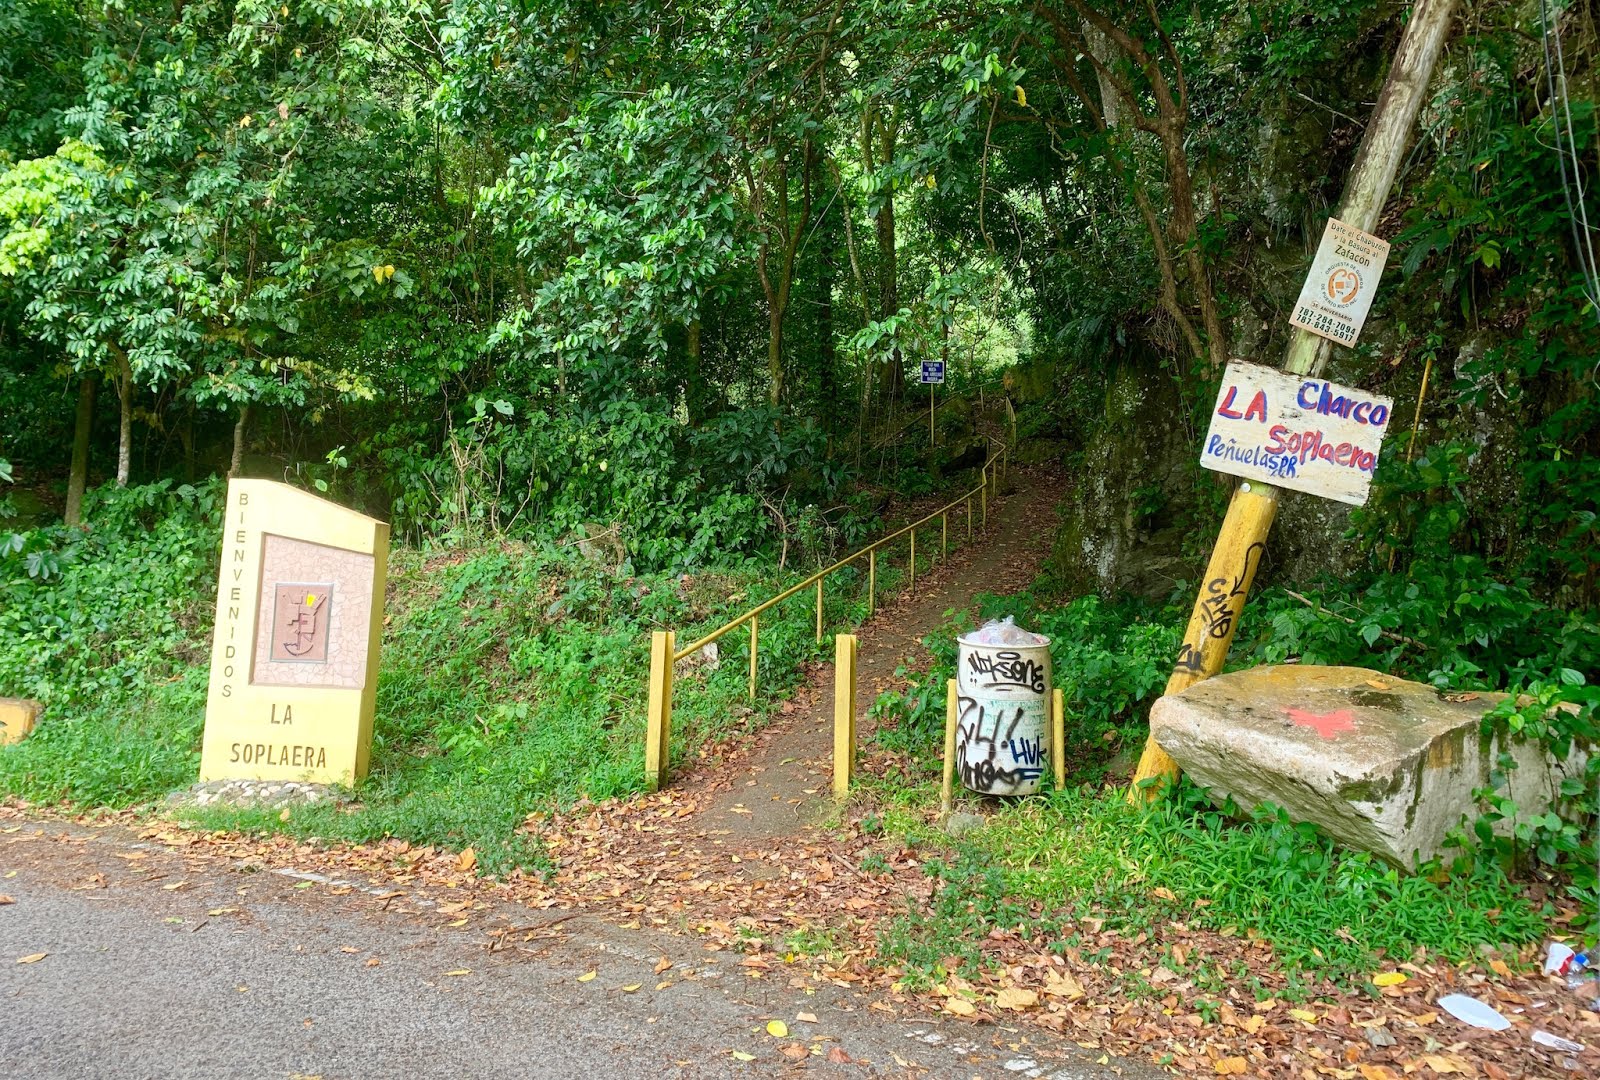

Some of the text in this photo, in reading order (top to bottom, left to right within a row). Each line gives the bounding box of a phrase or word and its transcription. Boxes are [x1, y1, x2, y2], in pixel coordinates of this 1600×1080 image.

[1331, 222, 1346, 235] Date
[1334, 244, 1370, 267] Zafacón
[1339, 236, 1346, 244] la
[1348, 239, 1371, 255] Basura
[1325, 261, 1350, 275] ORQUESTA
[1320, 283, 1326, 291] DE
[1322, 291, 1337, 308] PUERTO
[1299, 306, 1356, 335] 787-284-7094
[1320, 306, 1353, 322] ANIVERSARIO
[1296, 313, 1353, 342] 787-843-5917
[1217, 385, 1268, 424] LA
[1297, 381, 1389, 427] Charco
[1207, 433, 1279, 470] Peñuelas
[221, 493, 249, 698] BIENVENIDOS
[270, 703, 293, 726] LA
[229, 742, 327, 769] SOPLAERA
